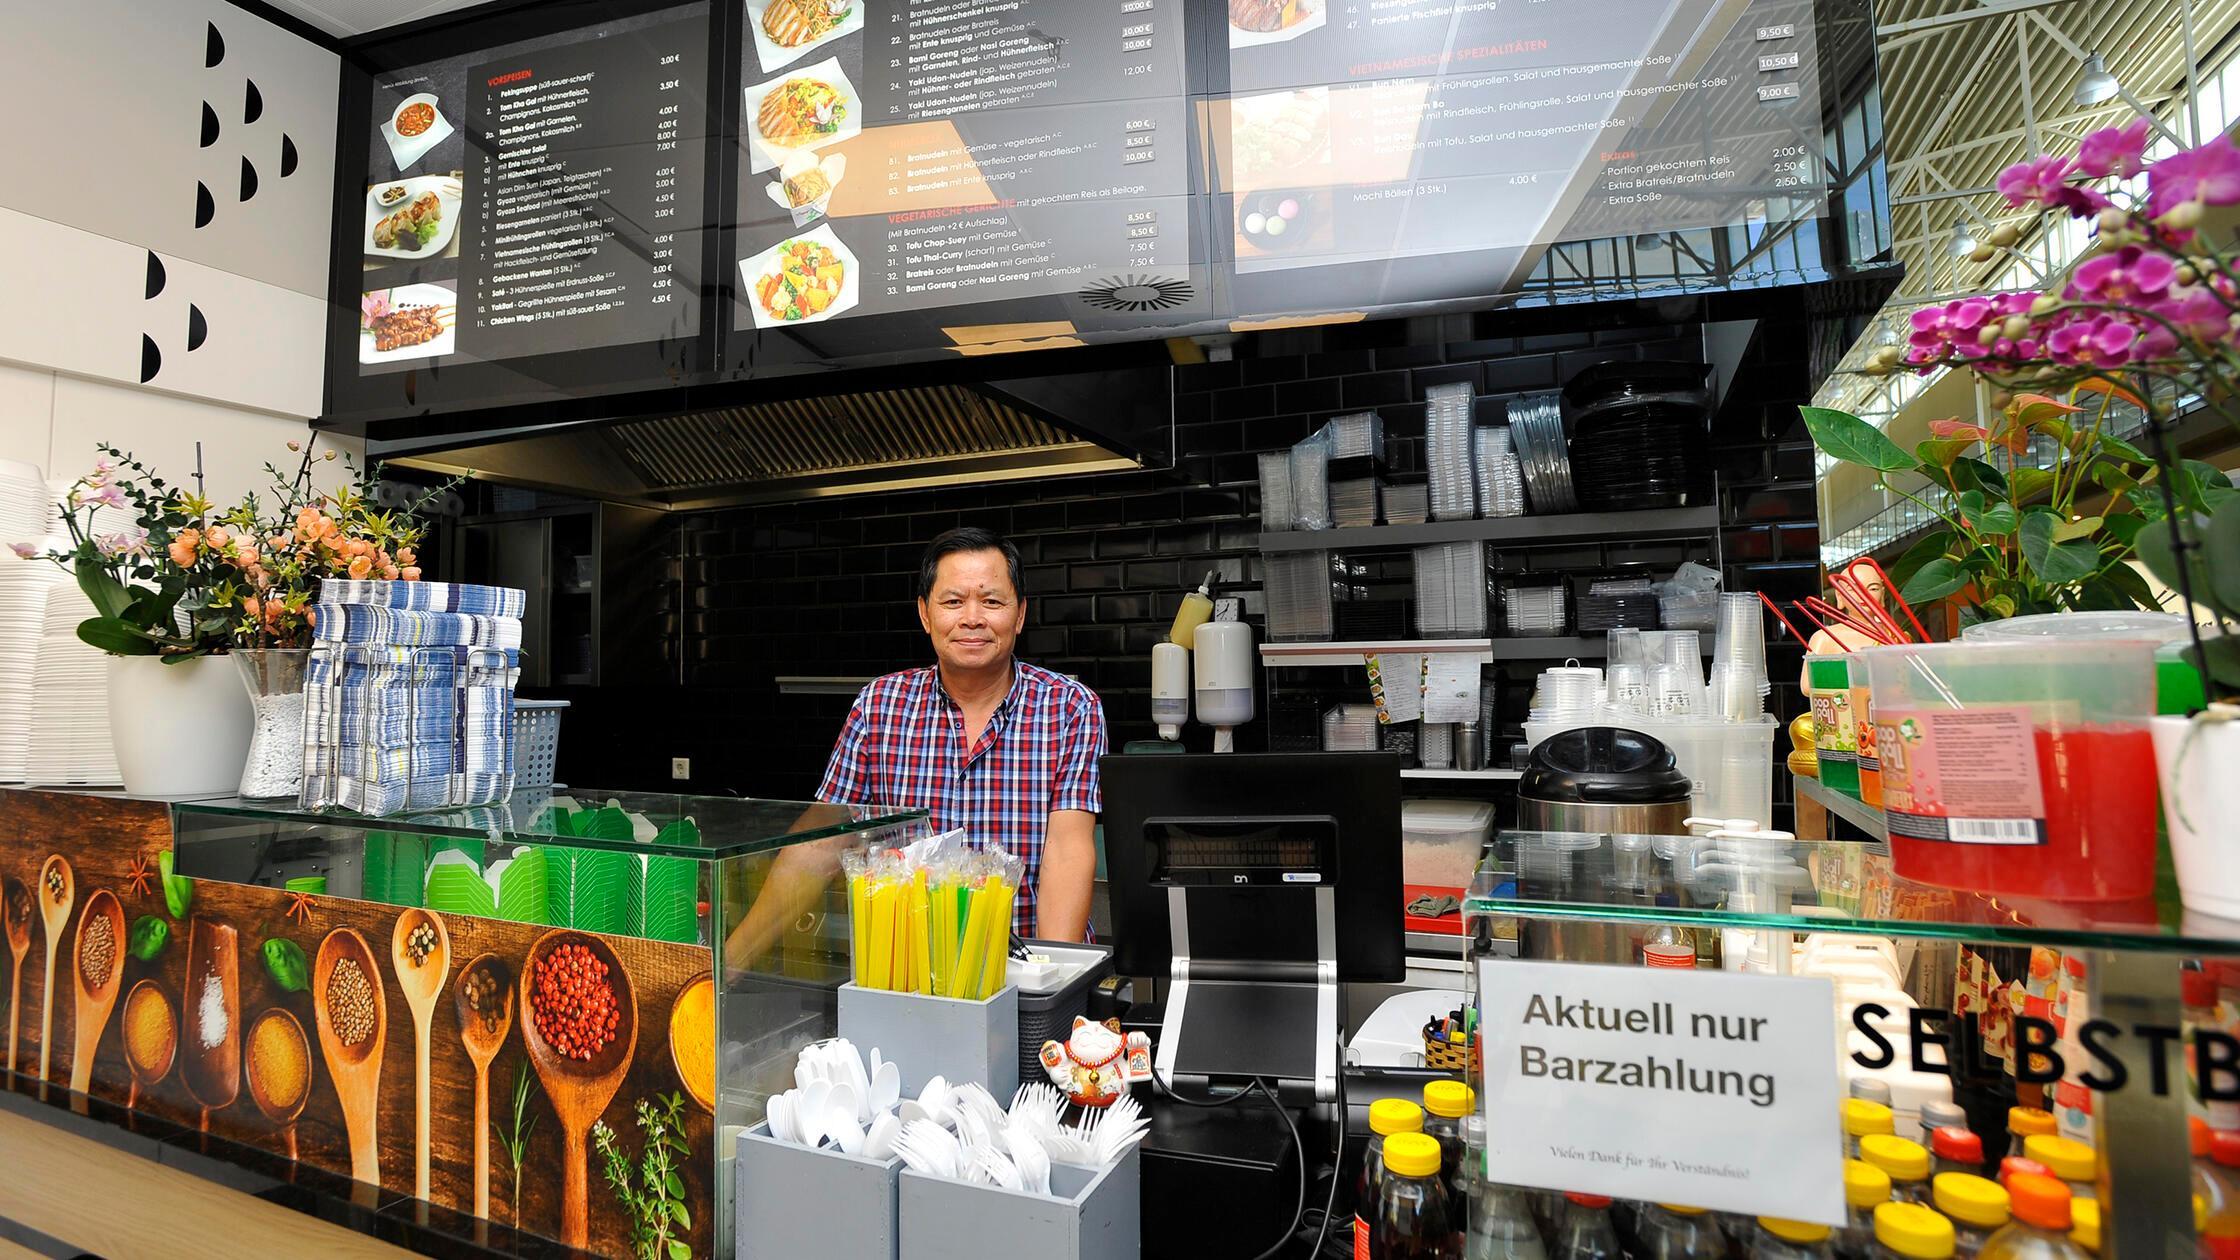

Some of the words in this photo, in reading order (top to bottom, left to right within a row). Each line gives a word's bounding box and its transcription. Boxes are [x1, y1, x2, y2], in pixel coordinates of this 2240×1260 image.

[910, 5, 950, 18] Bratnudeln
[952, 2, 970, 10] oder
[910, 20, 921, 28] mit
[923, 7, 984, 25] Hühnerschenkel
[985, 2, 1019, 13] knusprig
[1372, 12, 1409, 26] Panierte
[1456, 1, 1496, 13] knusprig
[909, 28, 950, 41] Bratnudeln
[952, 25, 970, 33] oder
[972, 18, 999, 29] Bratreis
[909, 42, 921, 50] mit
[923, 40, 939, 48] Ente
[941, 33, 972, 45] knusprig
[975, 29, 990, 38] und
[992, 25, 1025, 35] Gemüse
[1760, 28, 1781, 38] 9,50
[909, 65, 921, 73] mit
[983, 51, 998, 60] und
[1001, 43, 1054, 57] Hühnerfleisch
[930, 51, 958, 60] Goreng
[960, 46, 978, 54] oder
[1000, 38, 1029, 51] Goreng
[1514, 71, 1538, 81] Salat
[1541, 68, 1560, 78] und
[1563, 59, 1643, 75] hausgemachter
[1647, 56, 1671, 65] Soße
[1761, 57, 1786, 67] 10,50
[927, 70, 977, 83] Udon-Nudeln
[974, 72, 1015, 85] Rindfleisch
[1017, 67, 1055, 80] gebraten
[927, 93, 977, 107] Udon-Nudeln
[1426, 112, 1441, 120] mit
[1566, 93, 1591, 103] Salat
[1594, 90, 1613, 100] und
[1617, 80, 1699, 97] hausgemachter
[1702, 78, 1727, 88] Soße
[1761, 88, 1781, 97] 9,00
[542, 101, 576, 112] Kokosmilch
[922, 103, 980, 117] Riesengarnelen
[982, 97, 1019, 109] gebraten
[541, 126, 575, 136] Kokosmilch
[1428, 139, 1441, 147] mit
[1469, 134, 1492, 143] Salat
[1496, 131, 1515, 140] und
[1518, 123, 1597, 138] hausgemachter
[1600, 118, 1625, 129] Soße
[499, 149, 531, 160] Gemischter
[532, 144, 547, 153] Salat
[964, 144, 996, 154] Gemüse
[1004, 135, 1050, 148] vegetarisch
[1798, 146, 1805, 154] €
[964, 156, 1016, 169] Hühnerfleisch
[1018, 153, 1036, 161] oder
[1039, 145, 1081, 157] Rindfleisch
[1608, 166, 1643, 175] Portion
[1646, 160, 1706, 173] gekochtem
[1710, 155, 1730, 164] Reis
[1799, 161, 1806, 169] €
[983, 171, 1015, 184] knusprig
[1531, 175, 1537, 183] €
[1609, 181, 1633, 190] Extra
[1636, 170, 1734, 187] Bratreis/Bratnudeln
[1801, 176, 1807, 184] €
[1353, 191, 1382, 201] Mochi
[1609, 196, 1633, 204] Extra
[1637, 192, 1662, 202] Soße
[517, 202, 540, 212] Seafood
[888, 206, 961, 223] VEGETARISCHE
[1032, 193, 1079, 206] gekochtem
[1081, 190, 1097, 198] Reis
[1099, 188, 1110, 198] als
[496, 218, 539, 230] Riesengarnelen
[904, 225, 945, 236] Bratnudeln
[924, 237, 967, 247] Chop-Suey
[983, 230, 1016, 240] Gemüse
[495, 246, 540, 258] Vietnamesische
[542, 239, 582, 250] Frühlingsrollen
[906, 256, 922, 264] Tofu
[997, 244, 1009, 252] mit
[1012, 241, 1046, 251] Gemüse
[906, 268, 934, 278] Bratreis
[956, 261, 998, 272] Bratnudeln
[1001, 259, 1013, 267] mit
[1015, 255, 1048, 265] Gemüse
[493, 273, 528, 283] Gebackene
[927, 281, 957, 290] Goreng
[959, 278, 977, 286] oder
[999, 273, 1029, 281] Goreng
[1032, 270, 1044, 278] mit
[1046, 266, 1080, 276] Gemüse
[515, 282, 554, 293] Hühnerspieße
[491, 302, 513, 310] Yakitori
[544, 292, 584, 303] Hühnerspieße
[491, 317, 515, 325] Chicken
[1523, 994, 1673, 1035] Aktuell
[1692, 1012, 1768, 1041] nur
[1850, 1002, 2240, 1102] SELBSTB
[1520, 1045, 1775, 1107] Barzahlung
[1550, 1145, 1585, 1161] Vielen
[1589, 1150, 1622, 1165] Dank
[1622, 1152, 1644, 1171] für
[1647, 1157, 1668, 1171] Ihr
[1672, 1159, 1750, 1180] Verständnis!
